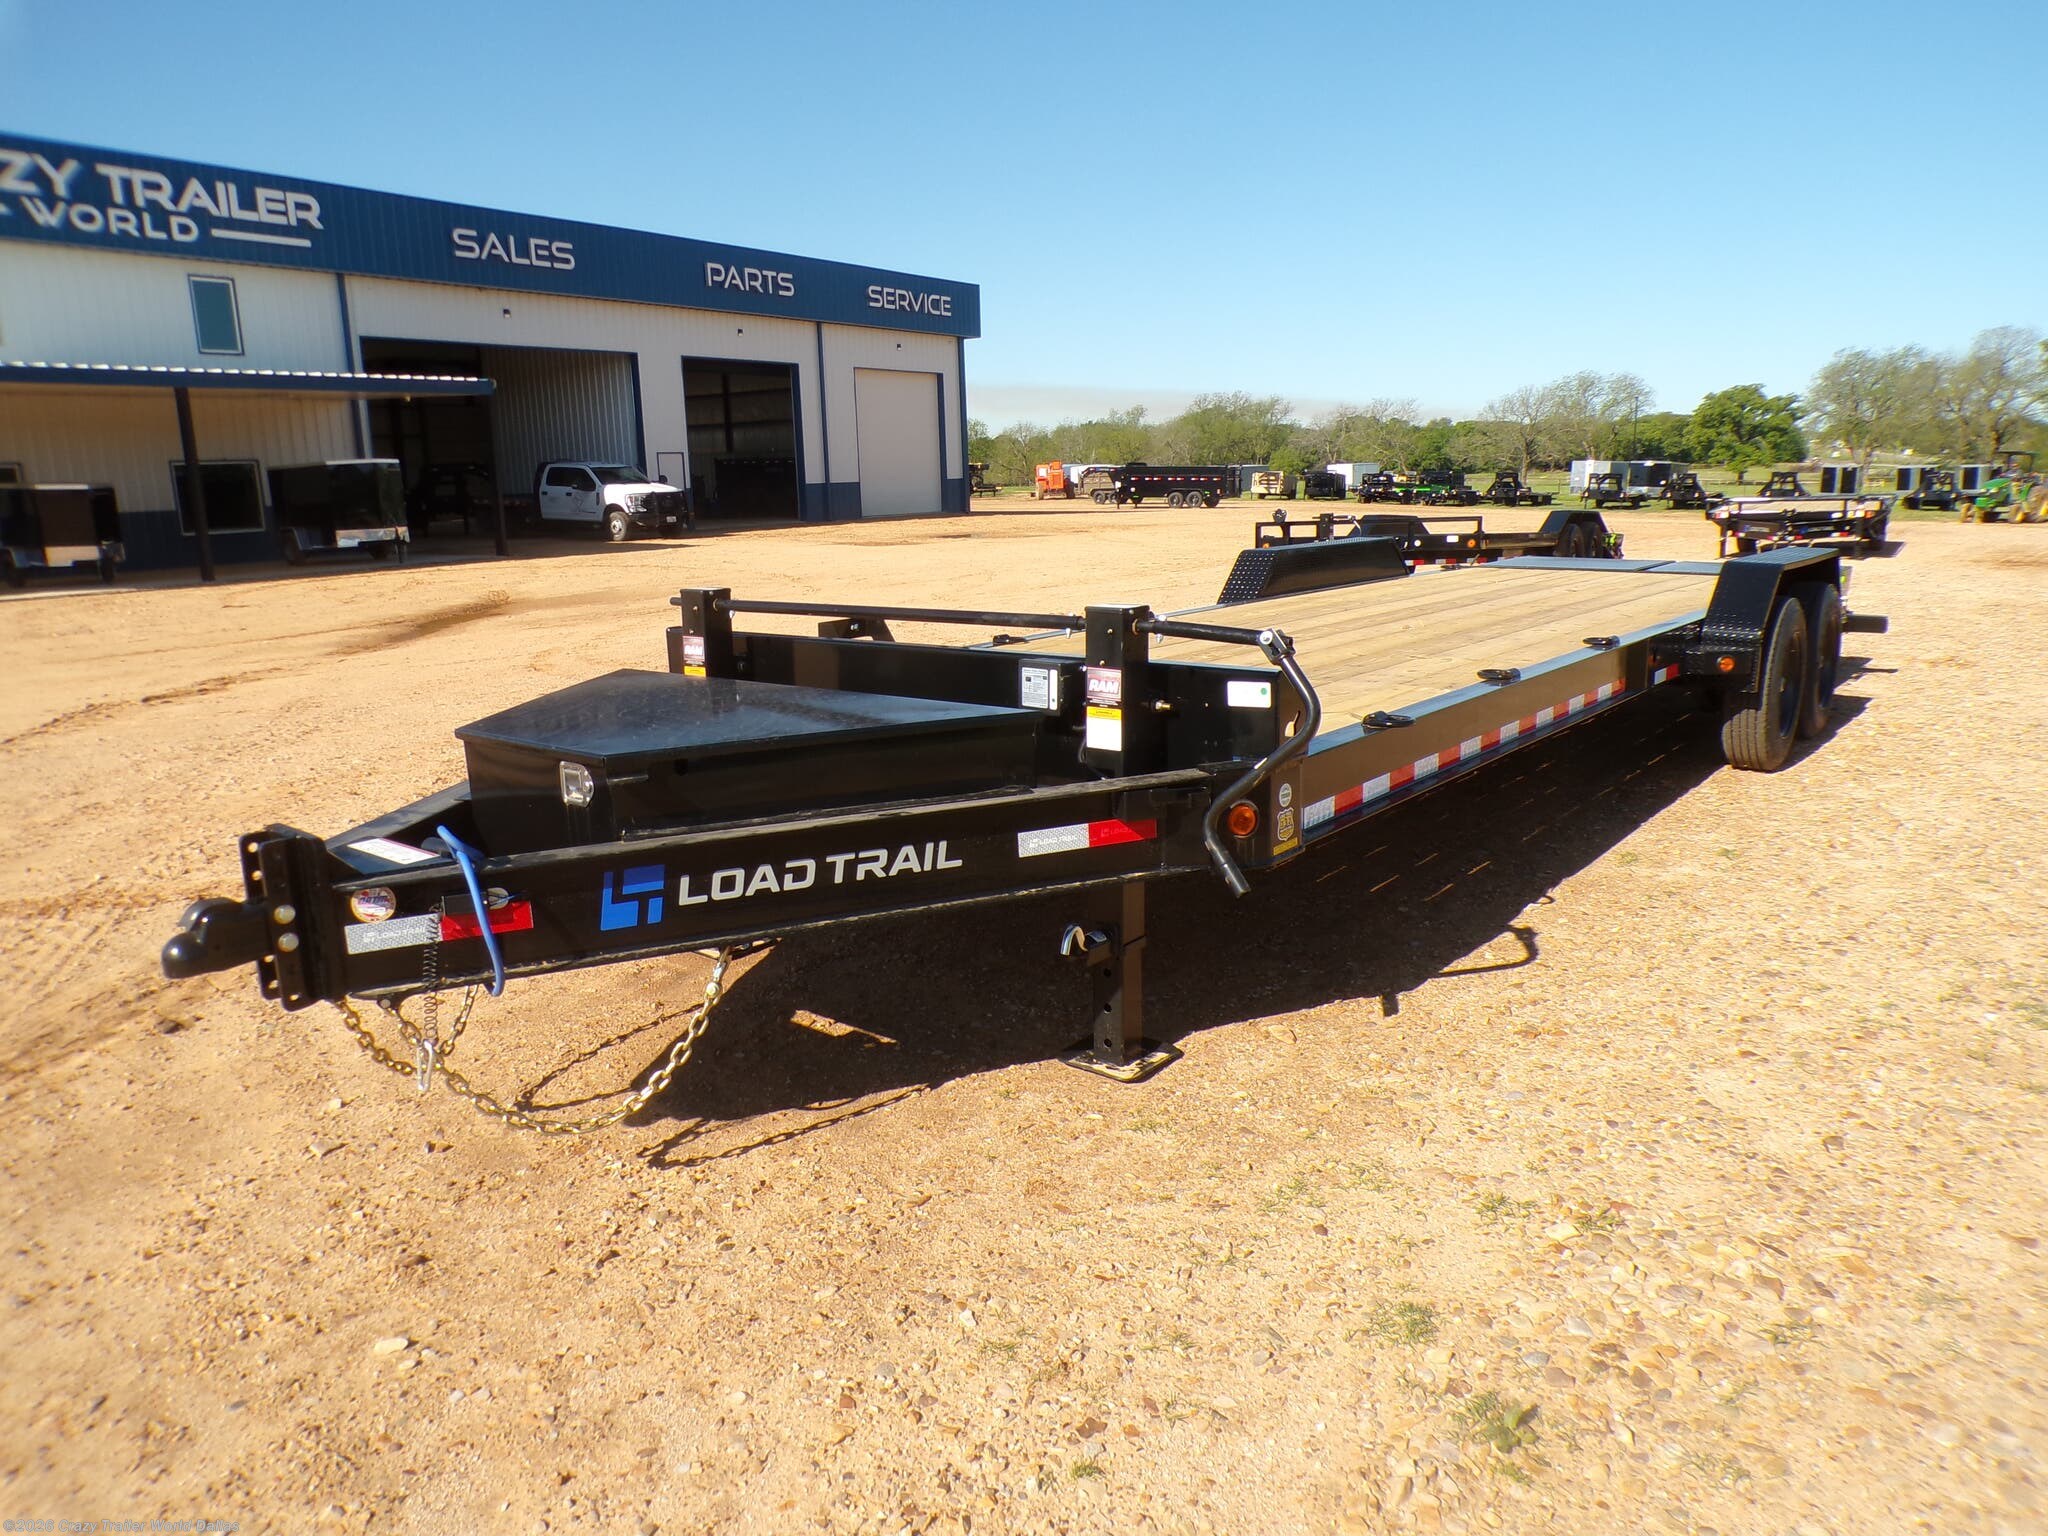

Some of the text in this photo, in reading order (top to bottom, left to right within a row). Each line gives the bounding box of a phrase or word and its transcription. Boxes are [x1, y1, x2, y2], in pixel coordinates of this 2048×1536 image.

[95, 162, 324, 230] TRAILER
[20, 194, 200, 243] WORLD
[452, 227, 576, 271] SALES
[705, 261, 796, 297] PARTS
[867, 284, 953, 318] SERVICE
[1088, 678, 1120, 695] RAM
[678, 840, 963, 906] LOAD TRAIL
